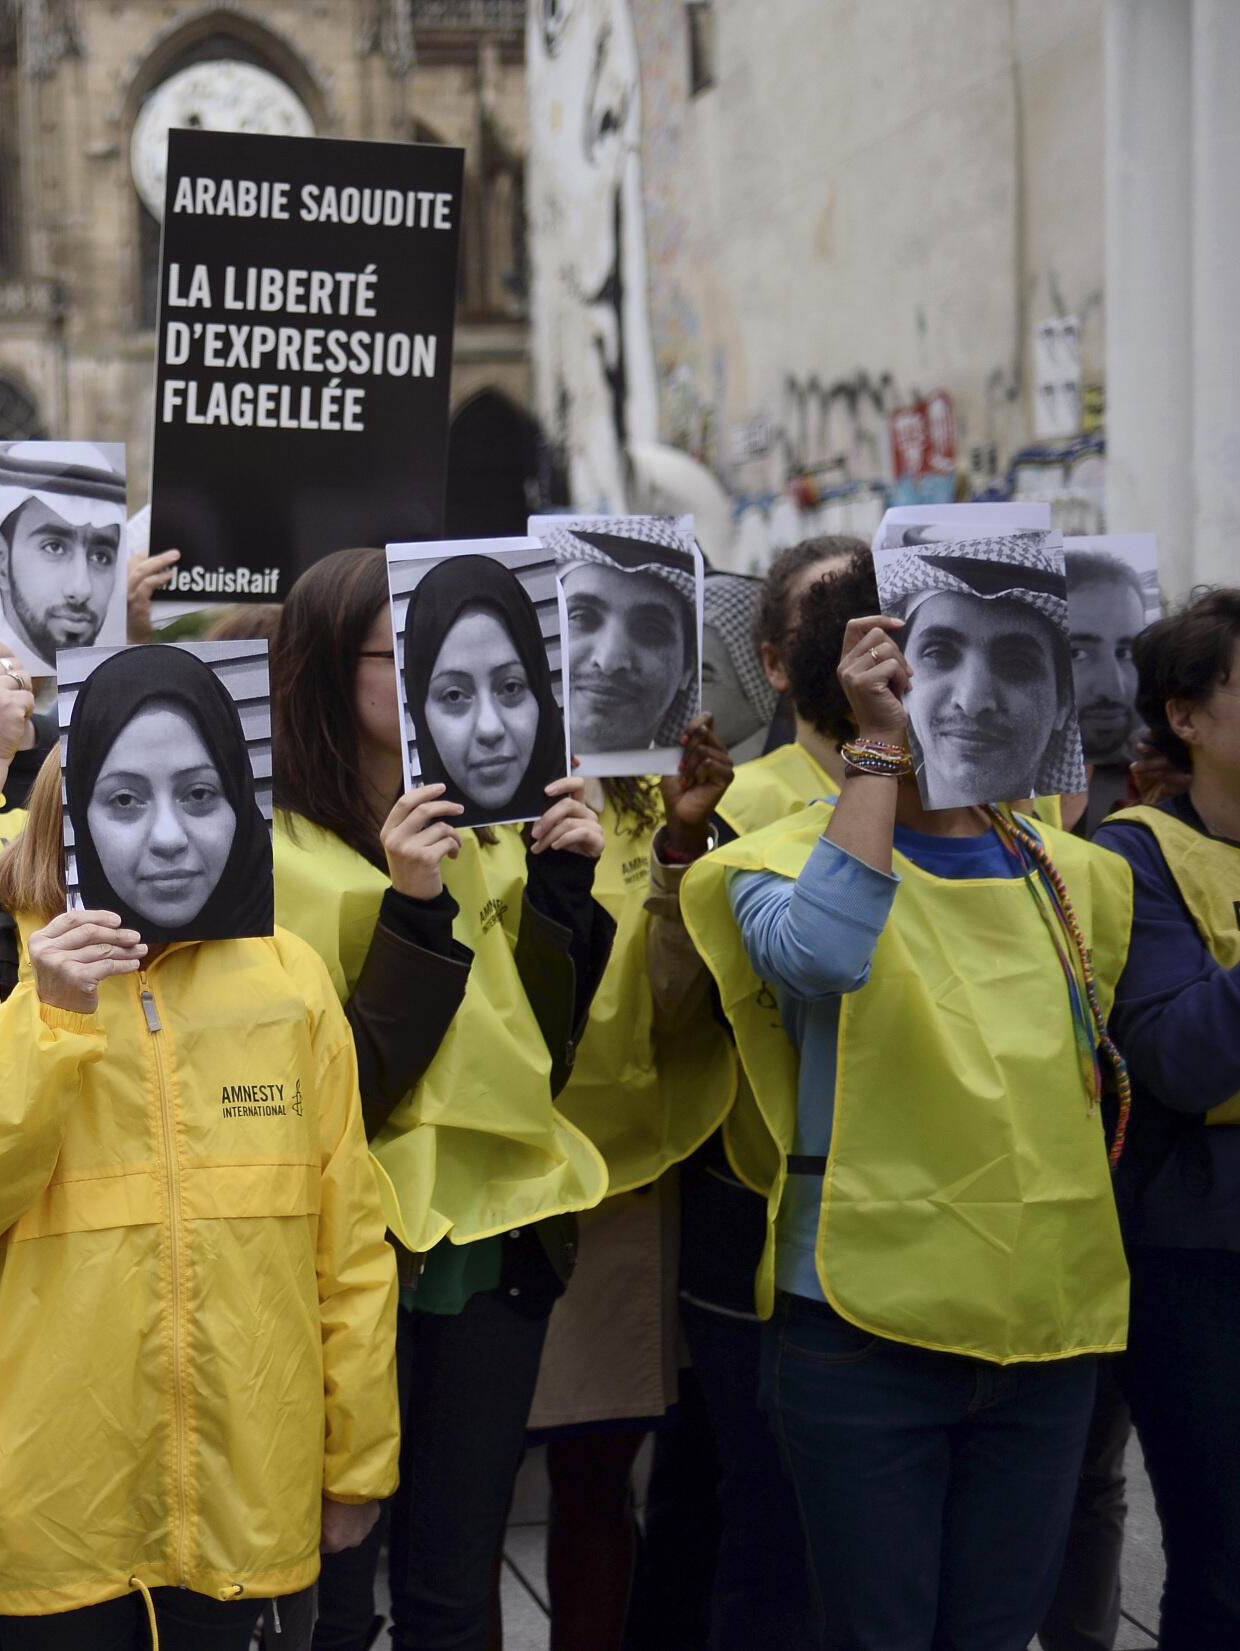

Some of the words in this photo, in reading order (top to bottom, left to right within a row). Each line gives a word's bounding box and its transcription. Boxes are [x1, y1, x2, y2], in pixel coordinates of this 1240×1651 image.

[173, 176, 291, 220] ARABIE
[300, 184, 453, 230] SAOUDITE
[168, 262, 212, 309] LA
[224, 263, 378, 317] LIBERTÉ
[165, 321, 437, 378] D'EXPRESSION
[162, 378, 366, 432] FLAGELLÉE
[160, 565, 280, 594] JeSuisRaif
[221, 1084, 285, 1104] AMNESTY
[223, 1105, 287, 1118] INTERNATIONAL
